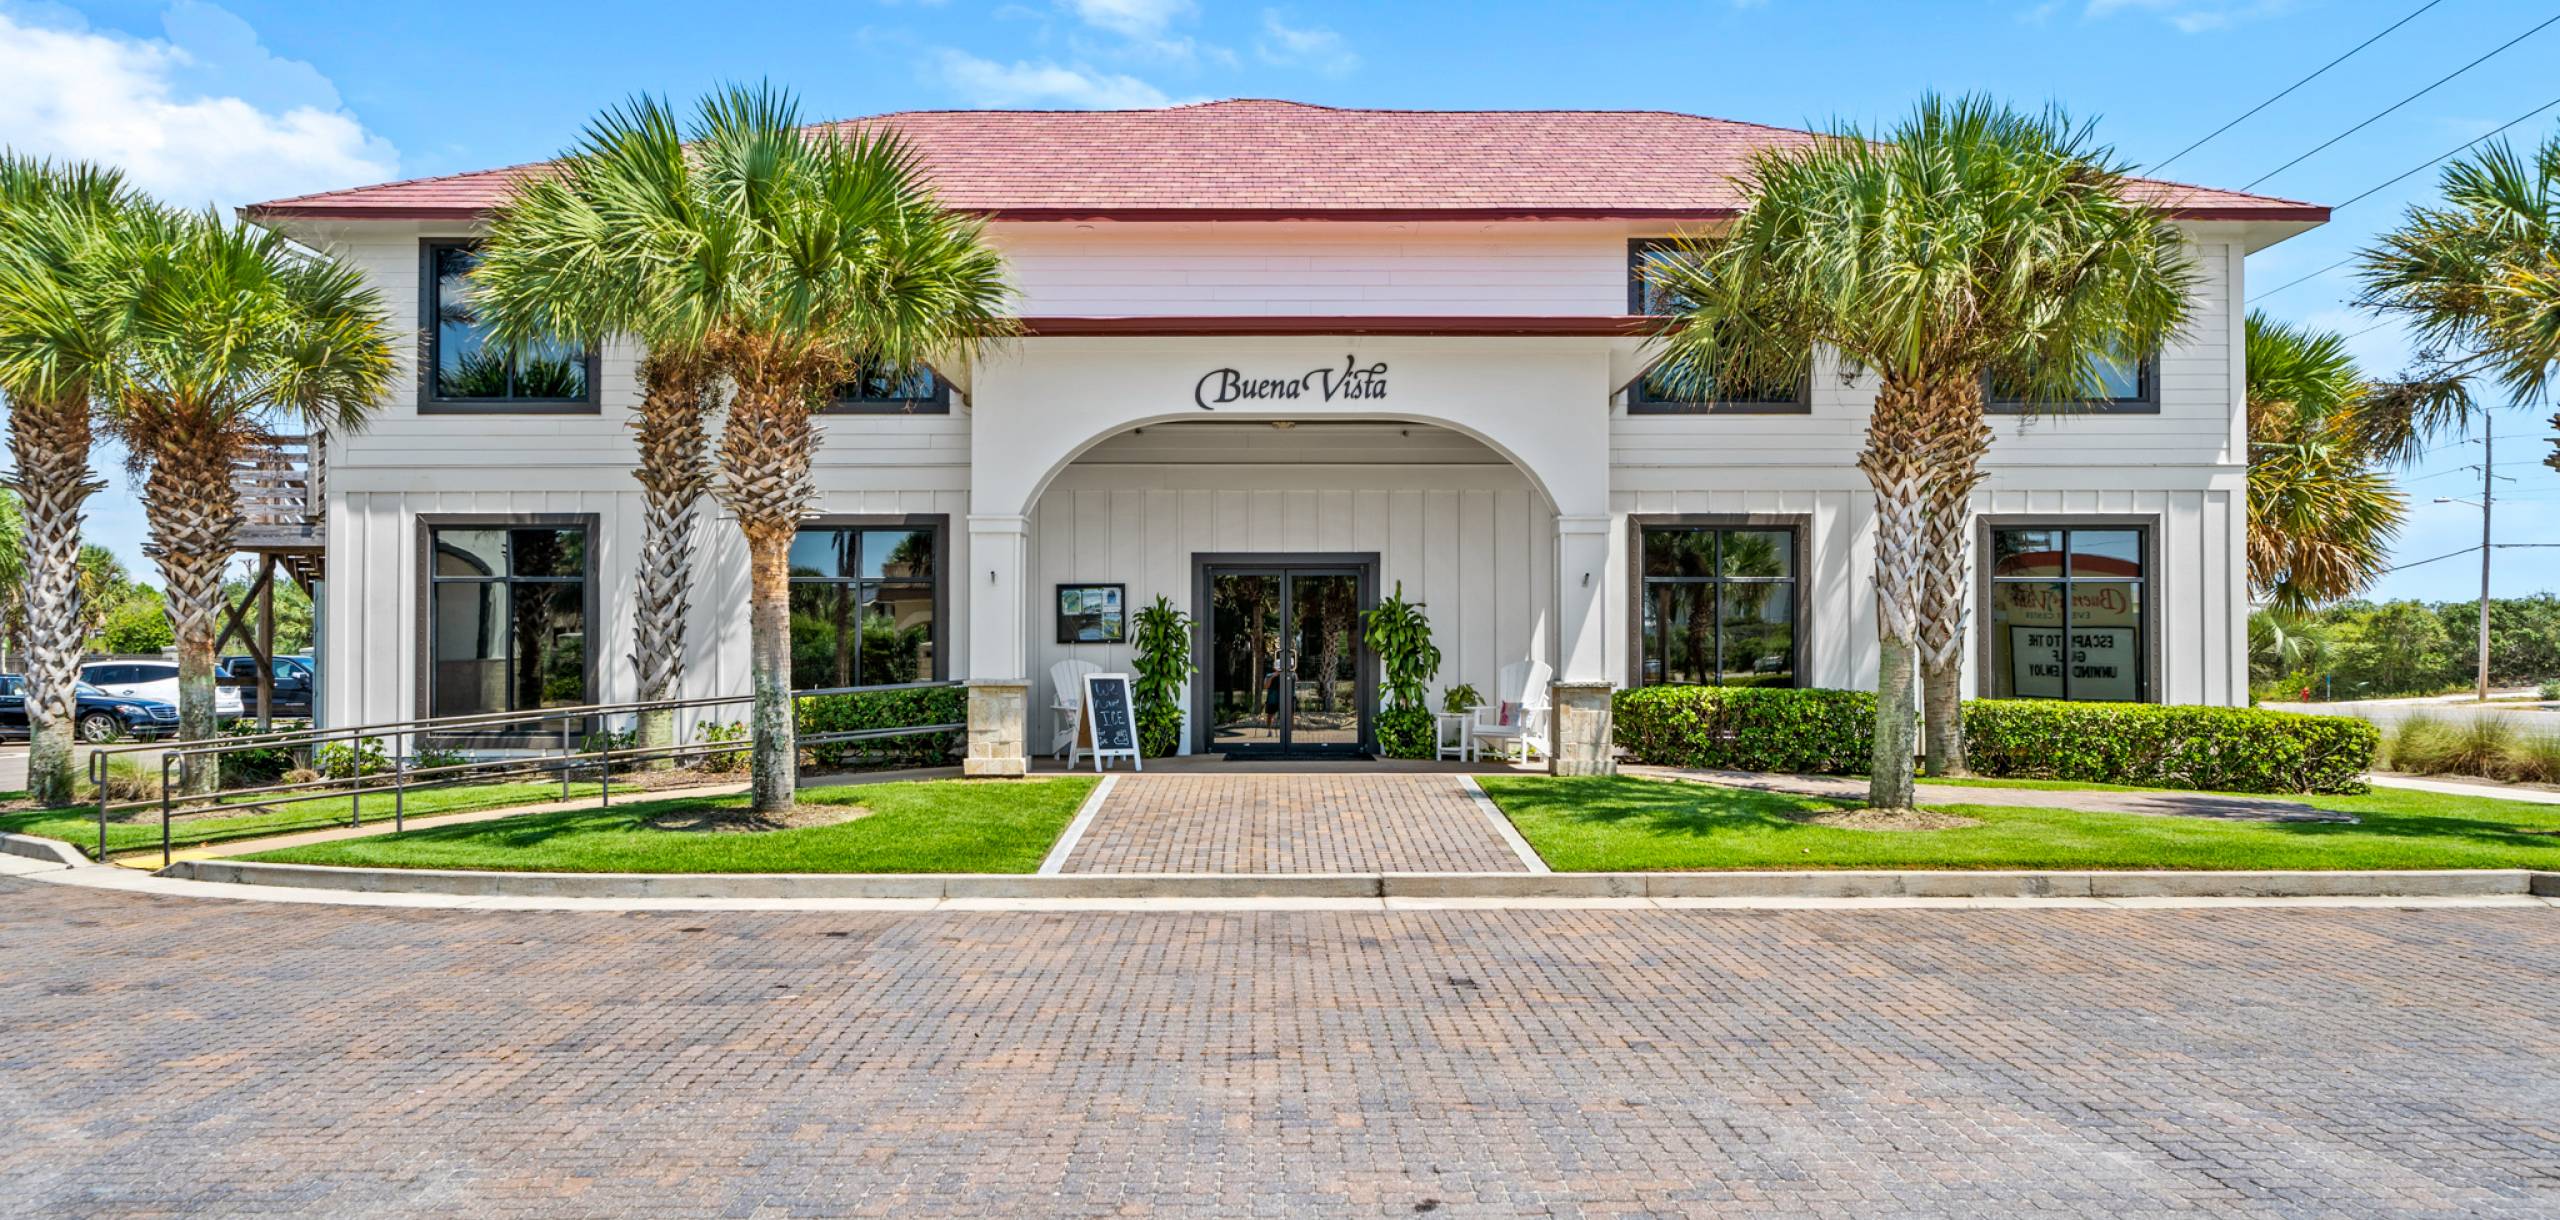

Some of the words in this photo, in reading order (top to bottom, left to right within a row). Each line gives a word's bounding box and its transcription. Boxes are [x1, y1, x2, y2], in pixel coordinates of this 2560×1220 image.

[1195, 367, 1300, 410] Buena
[1302, 354, 1388, 402] Vista
[1099, 710, 1126, 727] ICE
